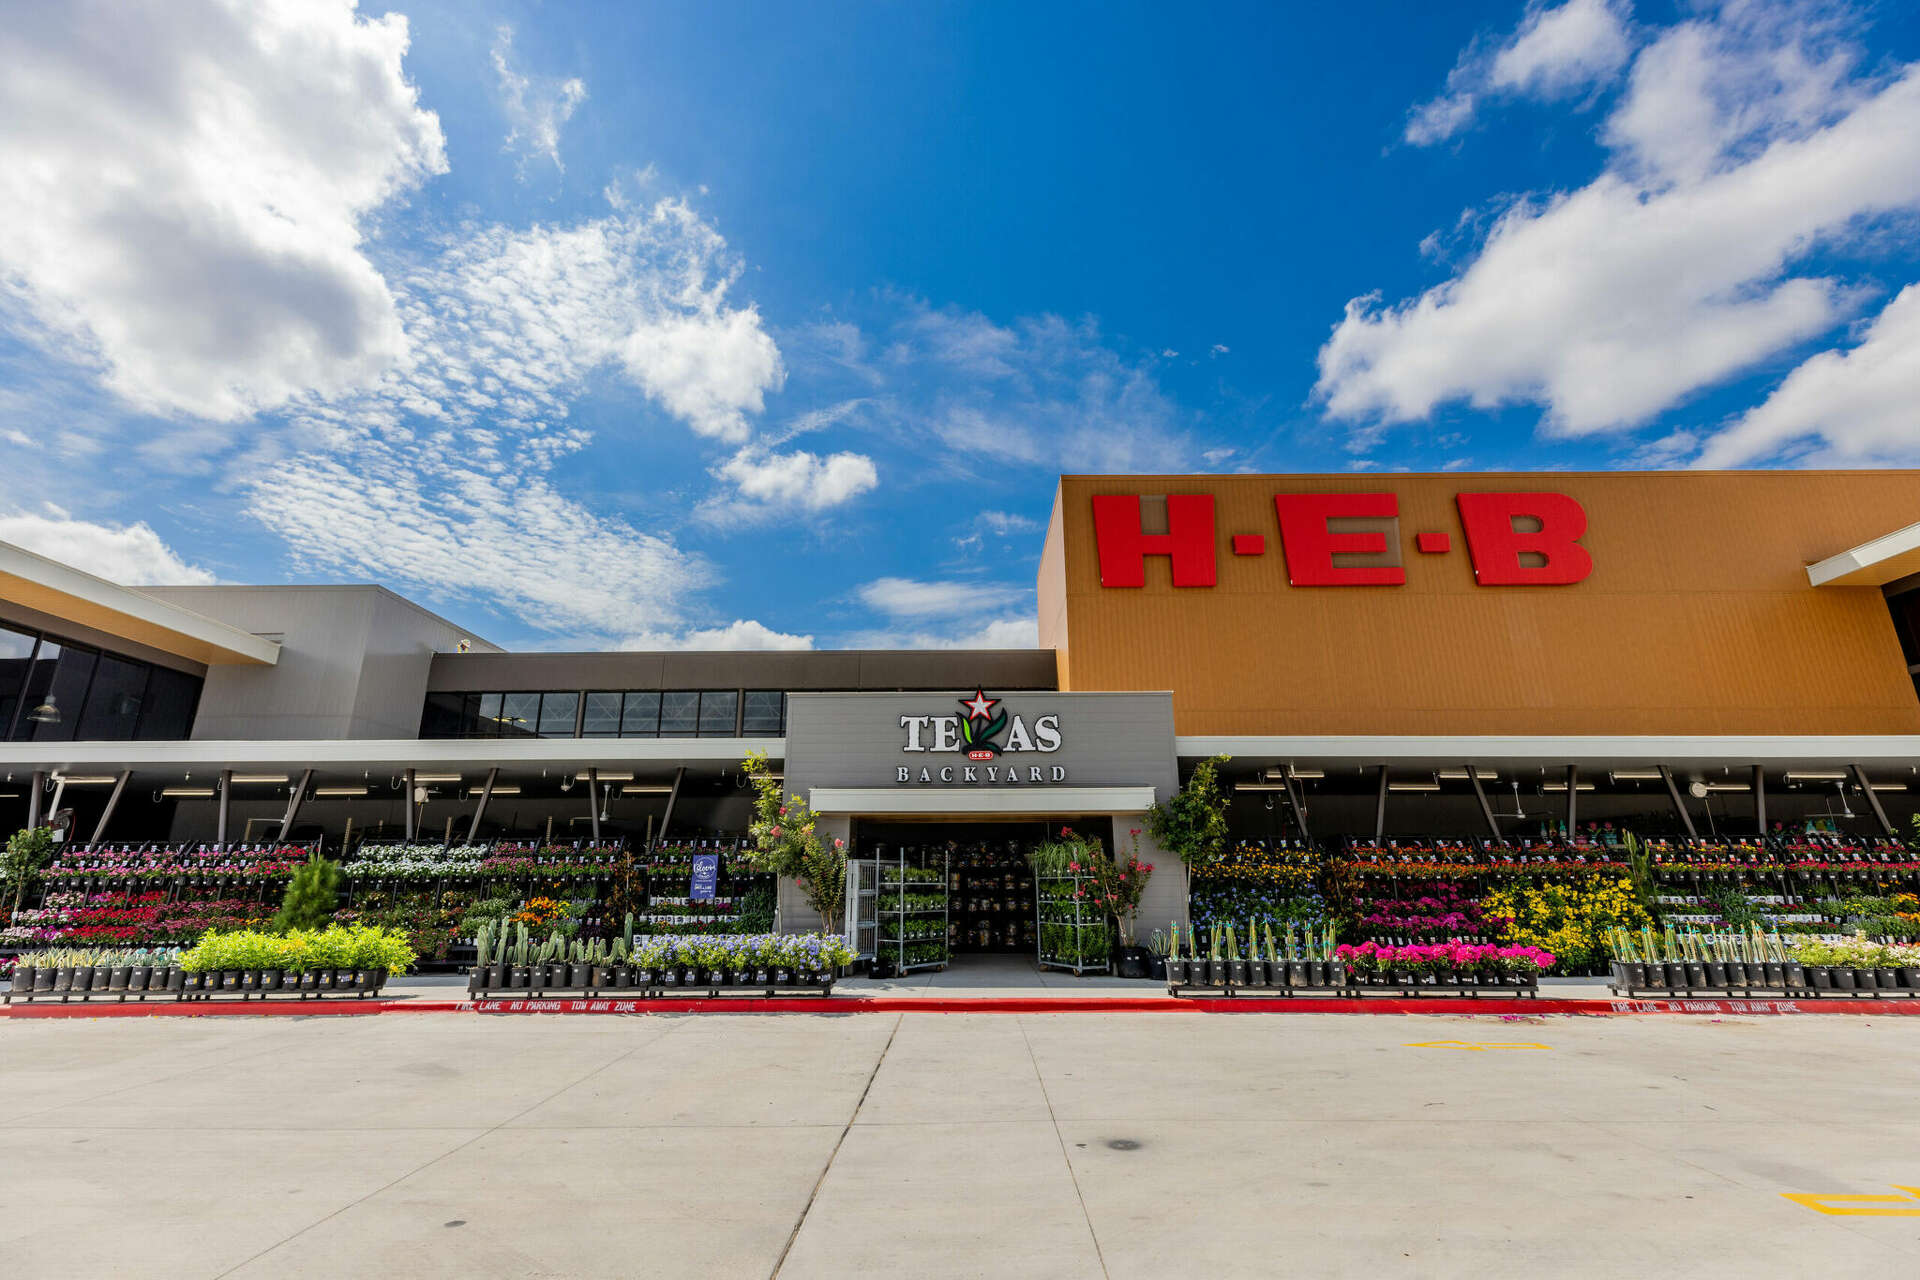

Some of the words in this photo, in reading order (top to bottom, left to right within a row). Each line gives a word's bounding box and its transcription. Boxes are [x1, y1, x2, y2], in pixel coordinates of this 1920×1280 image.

[1092, 492, 1593, 588] H-E-B
[896, 766, 1065, 783] BACKYARD
[456, 1002, 475, 1011] FIRE
[478, 1001, 501, 1011] LANE
[509, 1001, 523, 1011] NO
[526, 1001, 561, 1011] PARKING
[571, 1001, 587, 1011] TOW
[590, 1001, 611, 1011] AWAY
[614, 1001, 637, 1012] ZONE
[1611, 1001, 1633, 1013] FIRE
[1635, 1001, 1658, 1013] LANE
[1668, 1001, 1682, 1012] NO
[1684, 1001, 1721, 1012] PARKING
[1728, 1001, 1748, 1012] TOW
[1750, 1001, 1771, 1012] AWAY
[1774, 1001, 1798, 1012] ZONE
